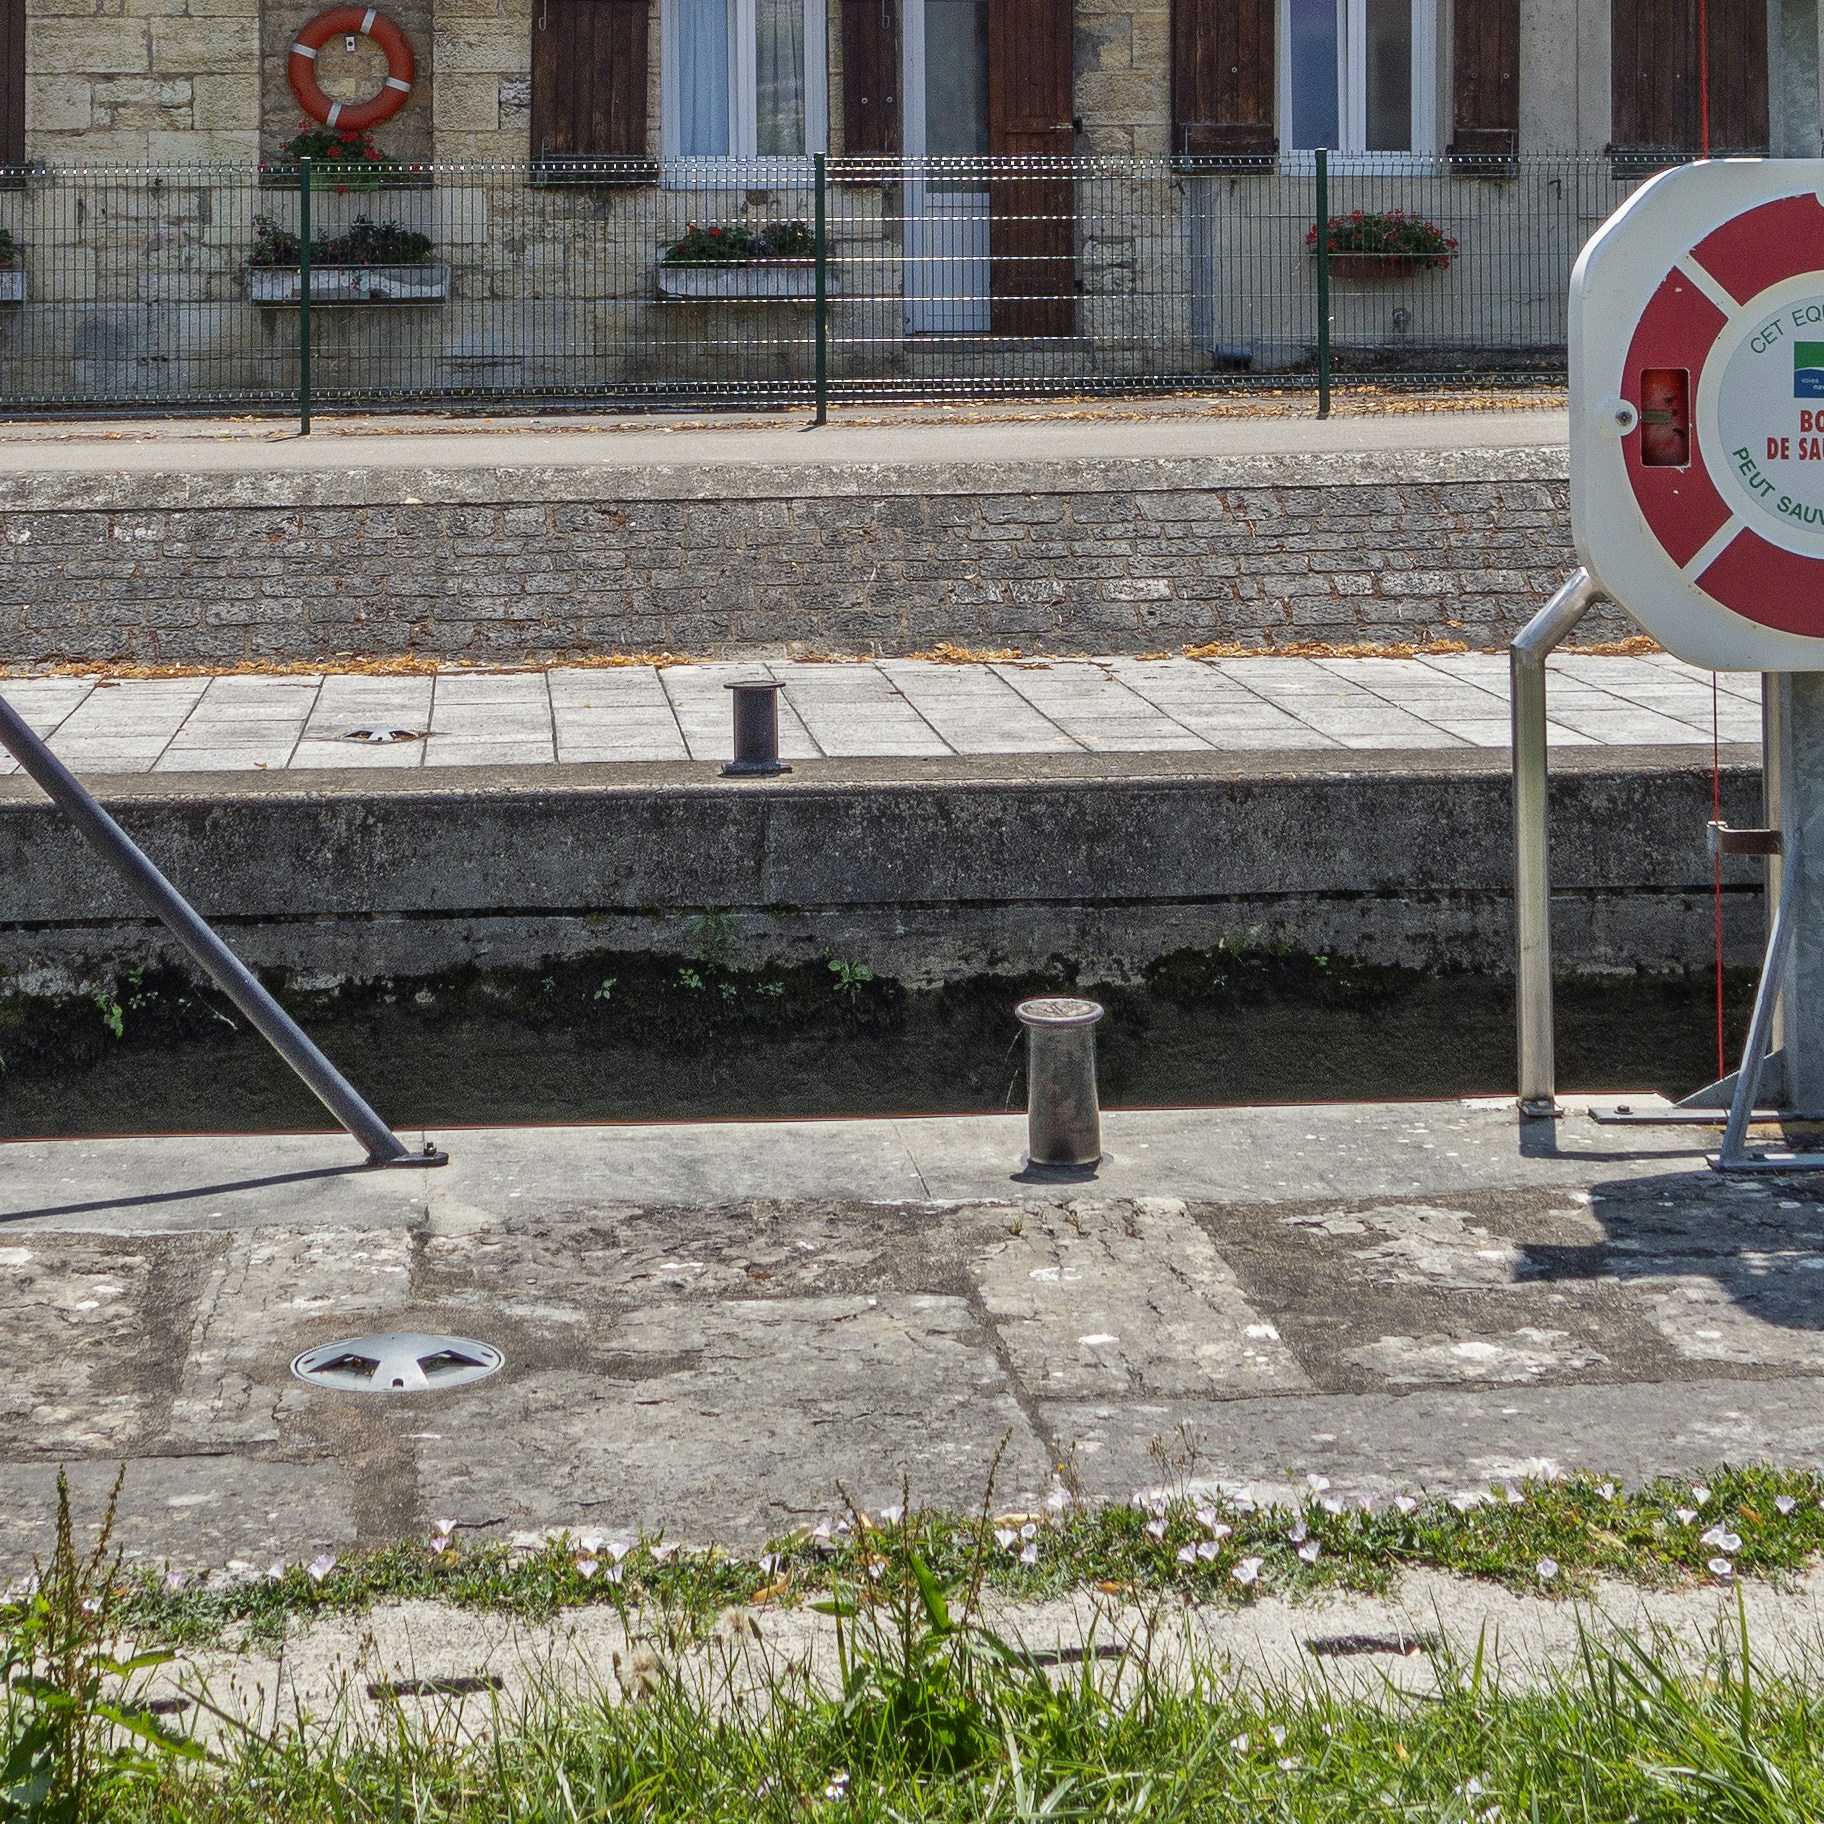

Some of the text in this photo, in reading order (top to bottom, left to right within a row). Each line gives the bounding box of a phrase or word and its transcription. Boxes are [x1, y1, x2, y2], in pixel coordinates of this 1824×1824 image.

[1750, 319, 1786, 355] CET
[1766, 438, 1790, 461] DE
[1732, 446, 1776, 498] PEUT
